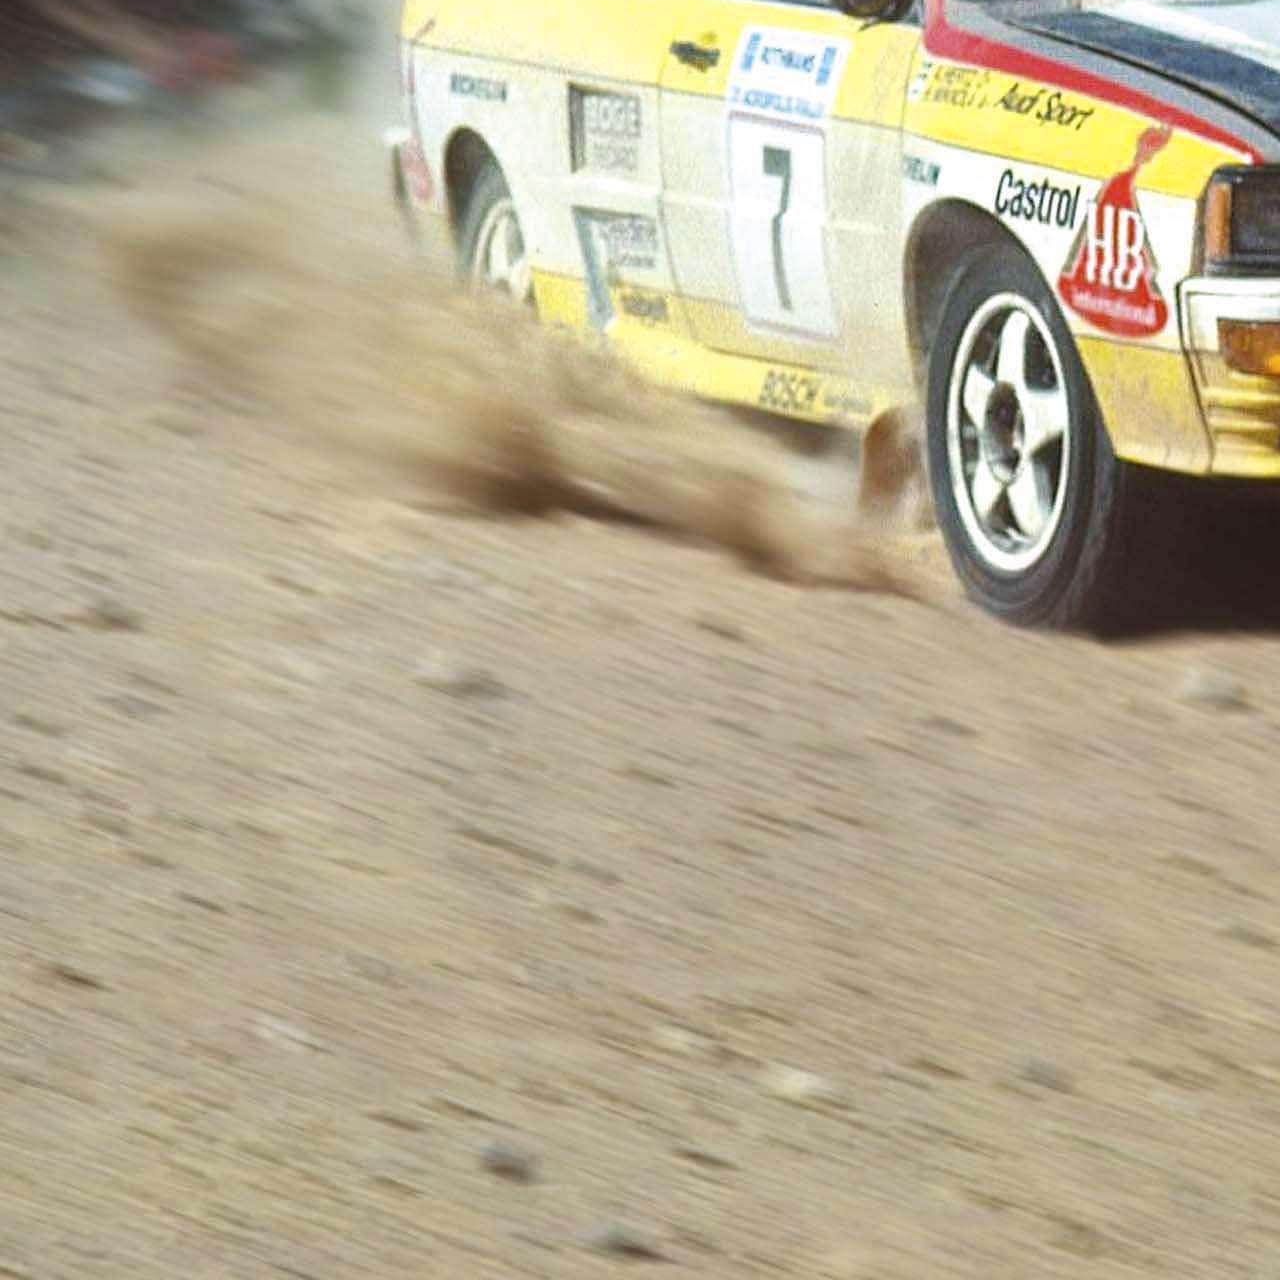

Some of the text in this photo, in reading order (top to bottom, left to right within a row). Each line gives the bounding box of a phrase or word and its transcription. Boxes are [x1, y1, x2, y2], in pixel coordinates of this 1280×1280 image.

[762, 145, 792, 312] 7
[994, 168, 1082, 230] Castrol
[1086, 198, 1146, 291] HB
